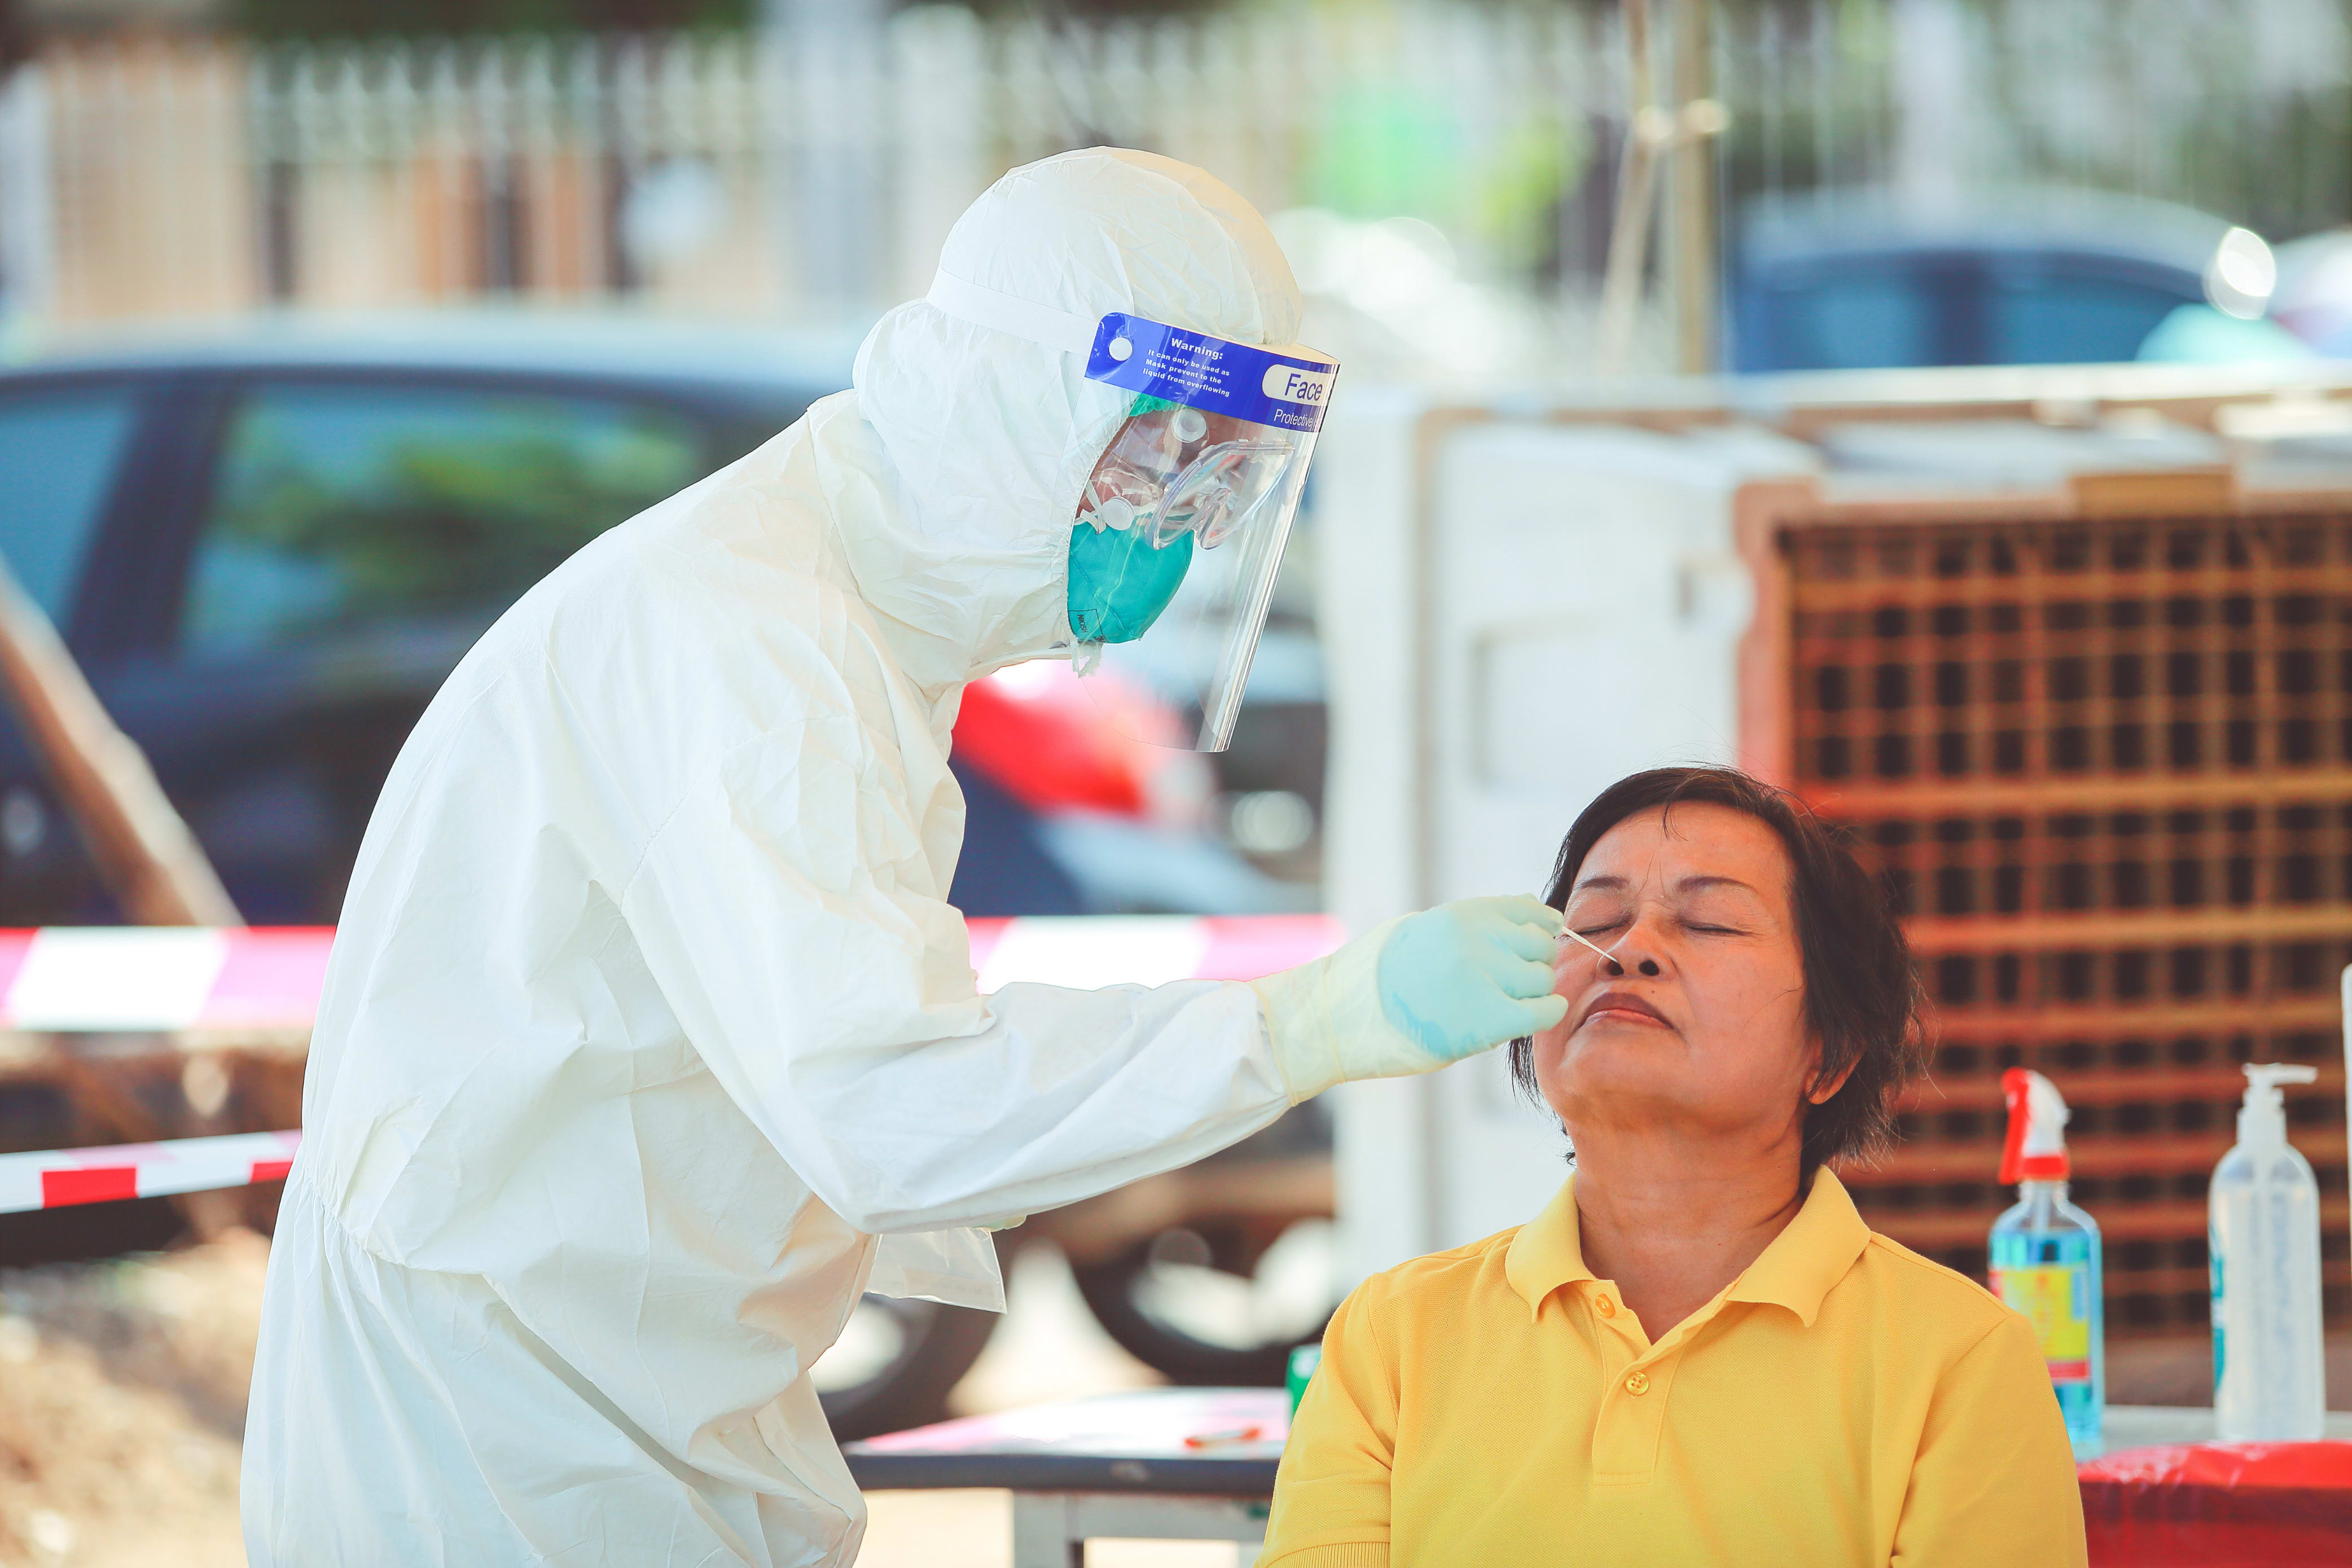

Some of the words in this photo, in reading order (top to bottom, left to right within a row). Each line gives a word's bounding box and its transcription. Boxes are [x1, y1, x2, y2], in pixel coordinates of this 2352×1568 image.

[1171, 337, 1223, 359] Warning:
[1145, 359, 1166, 369] Mask
[1169, 366, 1199, 377] prevent
[1173, 357, 1189, 366] only
[1201, 364, 1219, 373] used
[1143, 368, 1165, 379] liquid
[1167, 375, 1184, 384] from
[1187, 381, 1230, 397] overflowing
[1284, 373, 1323, 401] Face
[1274, 409, 1313, 427] Protective
[1077, 614, 1089, 633] NIOSH
